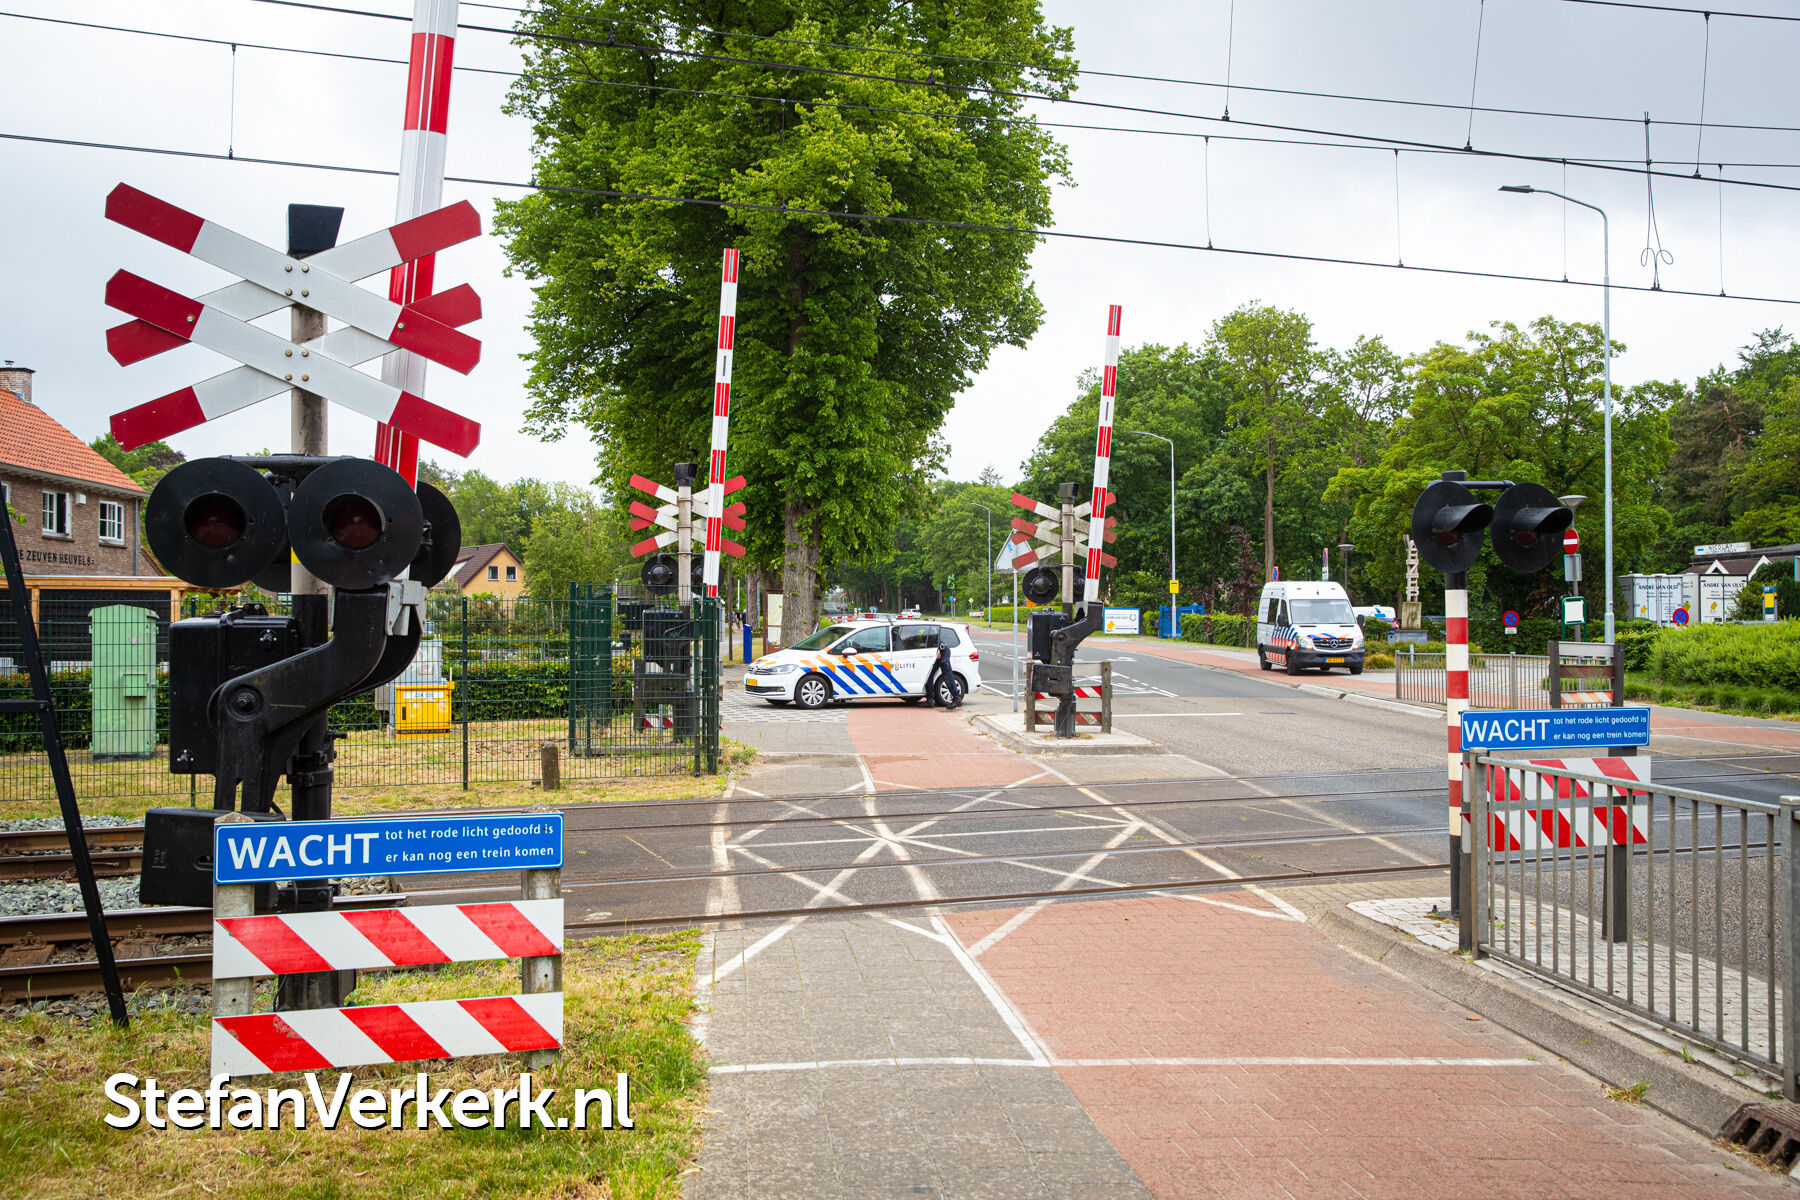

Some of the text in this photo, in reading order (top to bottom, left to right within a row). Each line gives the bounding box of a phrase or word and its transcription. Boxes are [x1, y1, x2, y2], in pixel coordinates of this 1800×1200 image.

[1595, 716, 1610, 724] licht
[1611, 716, 1638, 724] gedoofd
[1641, 715, 1646, 723] is
[1464, 719, 1550, 742] WACHT
[1578, 733, 1590, 741] nog
[386, 823, 553, 841] tot het rode licht gedoofd is
[228, 833, 379, 870] WACHT
[386, 845, 554, 864] er kan nog een trein komen
